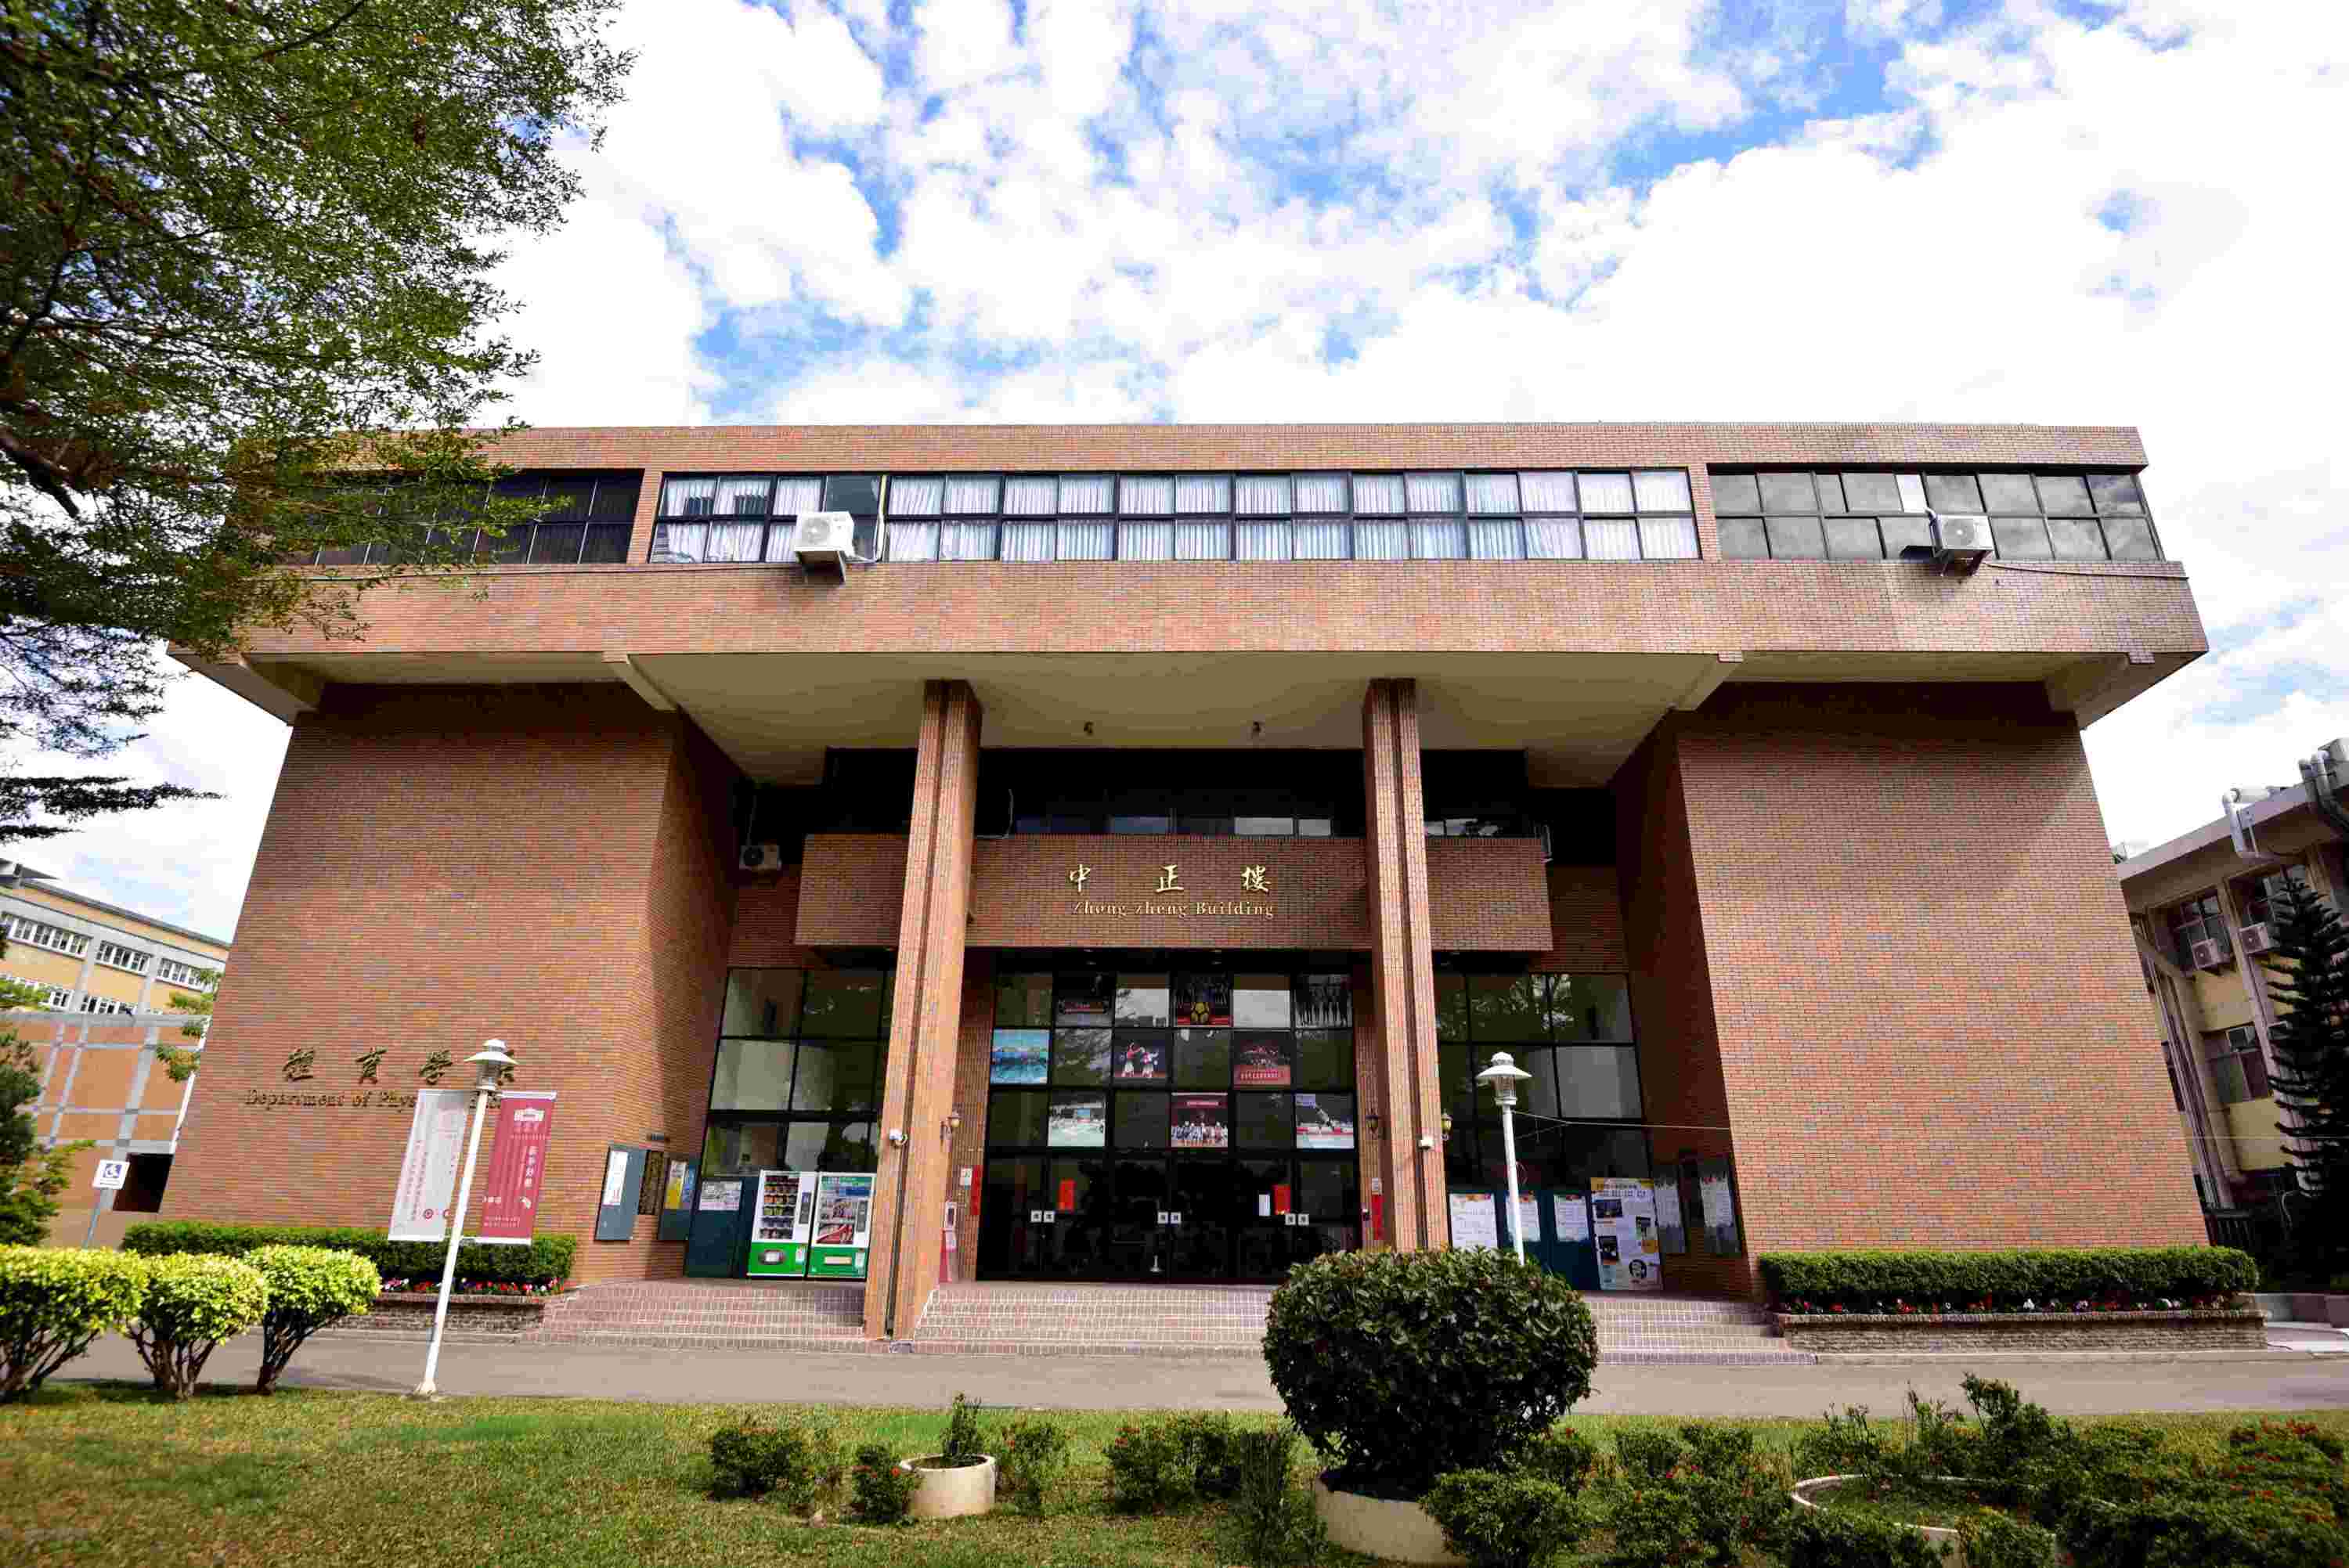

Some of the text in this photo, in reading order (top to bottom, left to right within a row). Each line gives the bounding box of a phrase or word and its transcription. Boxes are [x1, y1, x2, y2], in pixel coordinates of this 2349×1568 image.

[1071, 901, 1128, 920] Zhong
[1196, 901, 1273, 920] Building
[245, 1089, 345, 1111] Department
[351, 1090, 370, 1107] of
